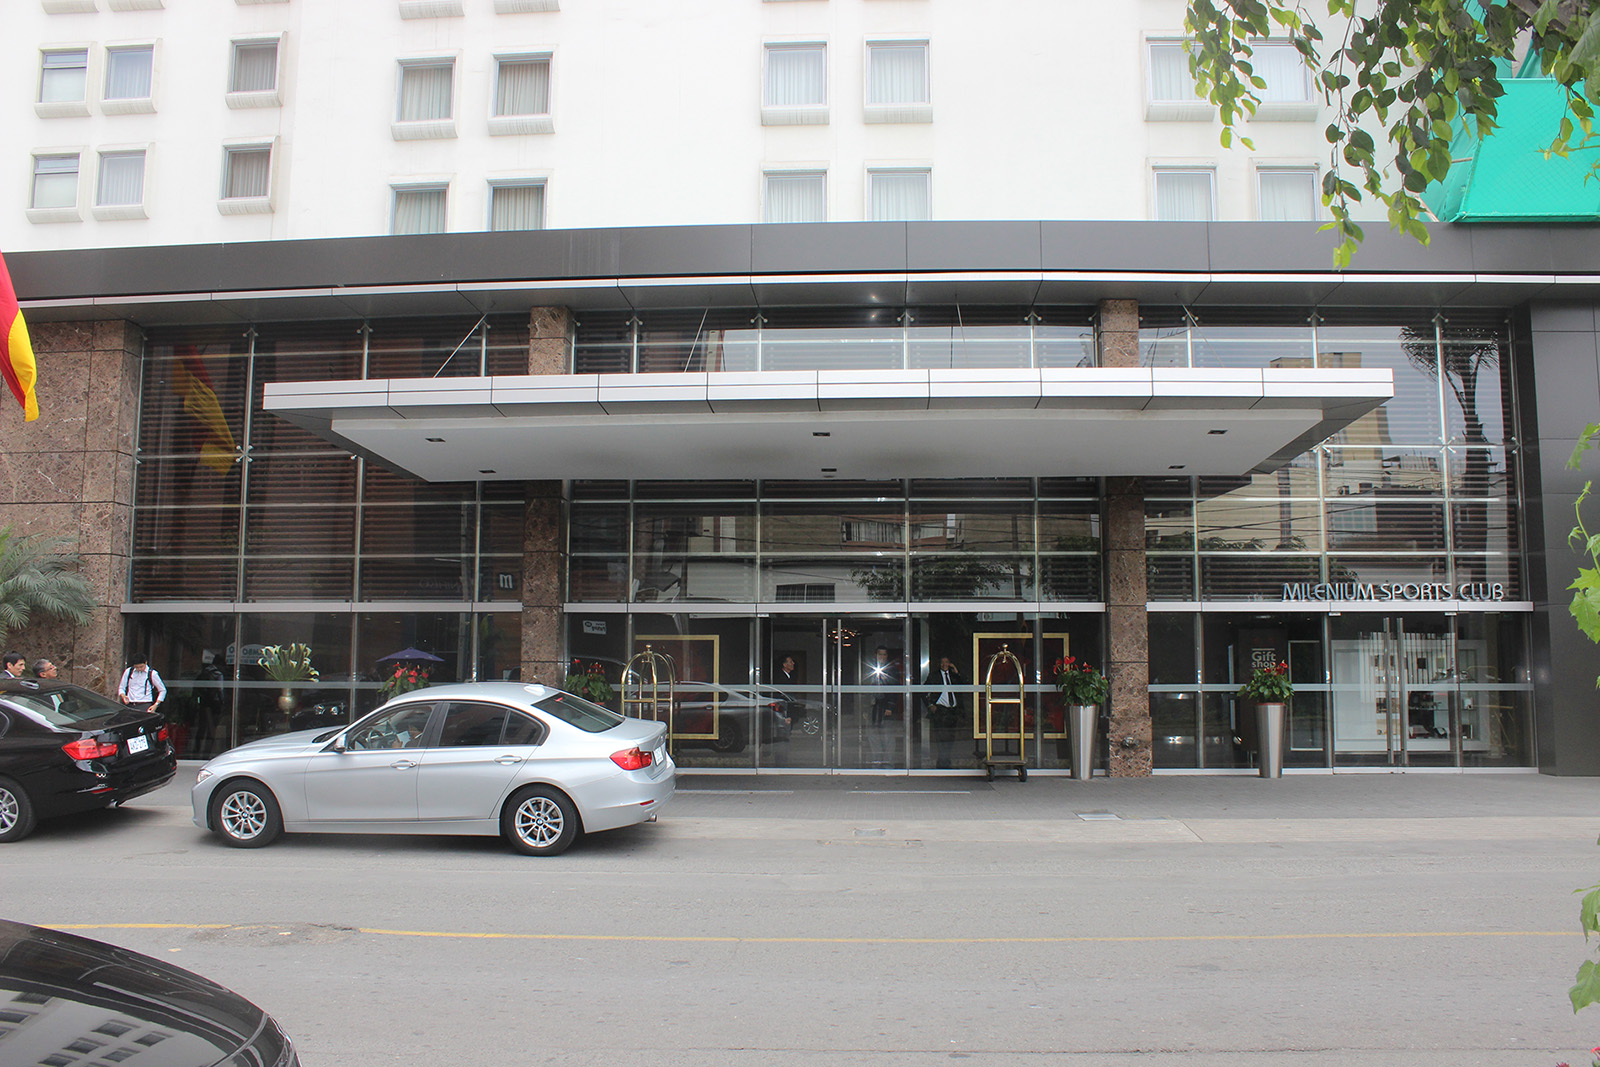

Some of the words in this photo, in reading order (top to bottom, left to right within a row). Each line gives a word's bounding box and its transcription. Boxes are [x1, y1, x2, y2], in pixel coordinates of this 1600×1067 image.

[1282, 582, 1375, 601] MILENIUM
[1380, 582, 1453, 601] SPORTS
[1459, 582, 1504, 601] CLUB
[1251, 651, 1276, 661] Gift
